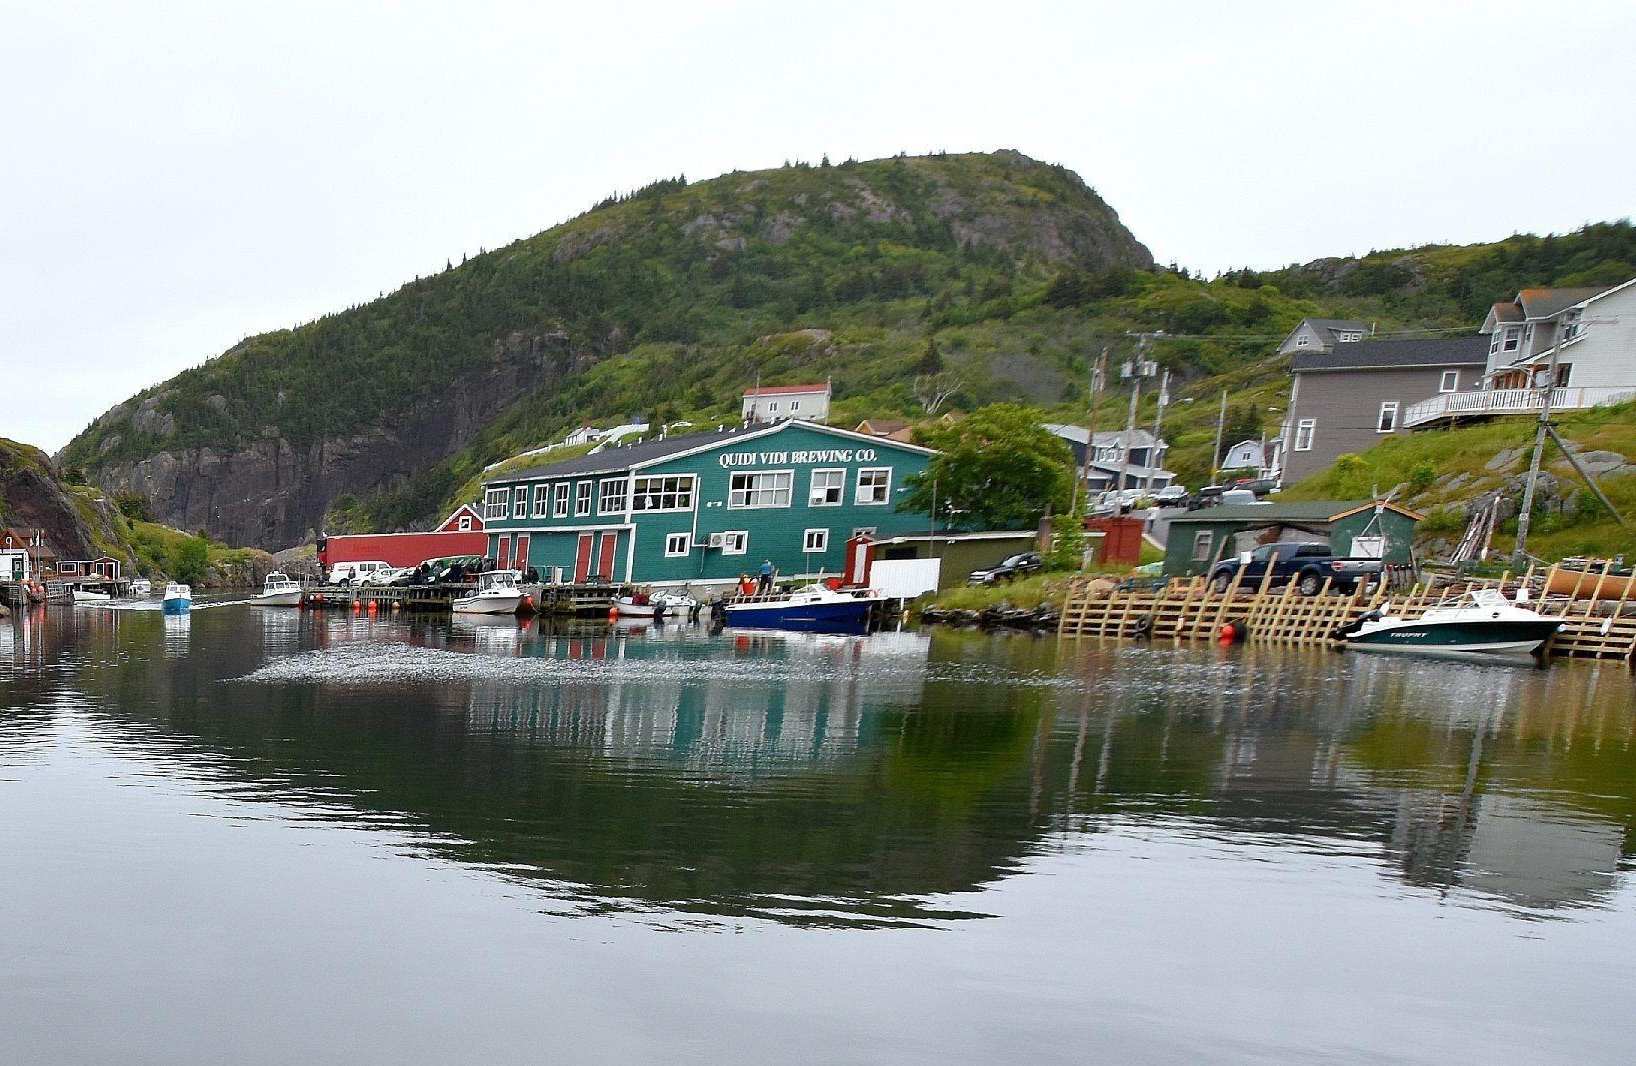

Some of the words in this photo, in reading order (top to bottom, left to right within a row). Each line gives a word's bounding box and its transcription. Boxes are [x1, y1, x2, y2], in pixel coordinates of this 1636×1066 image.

[719, 452, 757, 468] QUIDI
[760, 451, 788, 465] VIDI
[790, 449, 853, 464] BREWING
[855, 448, 878, 462] CO.
